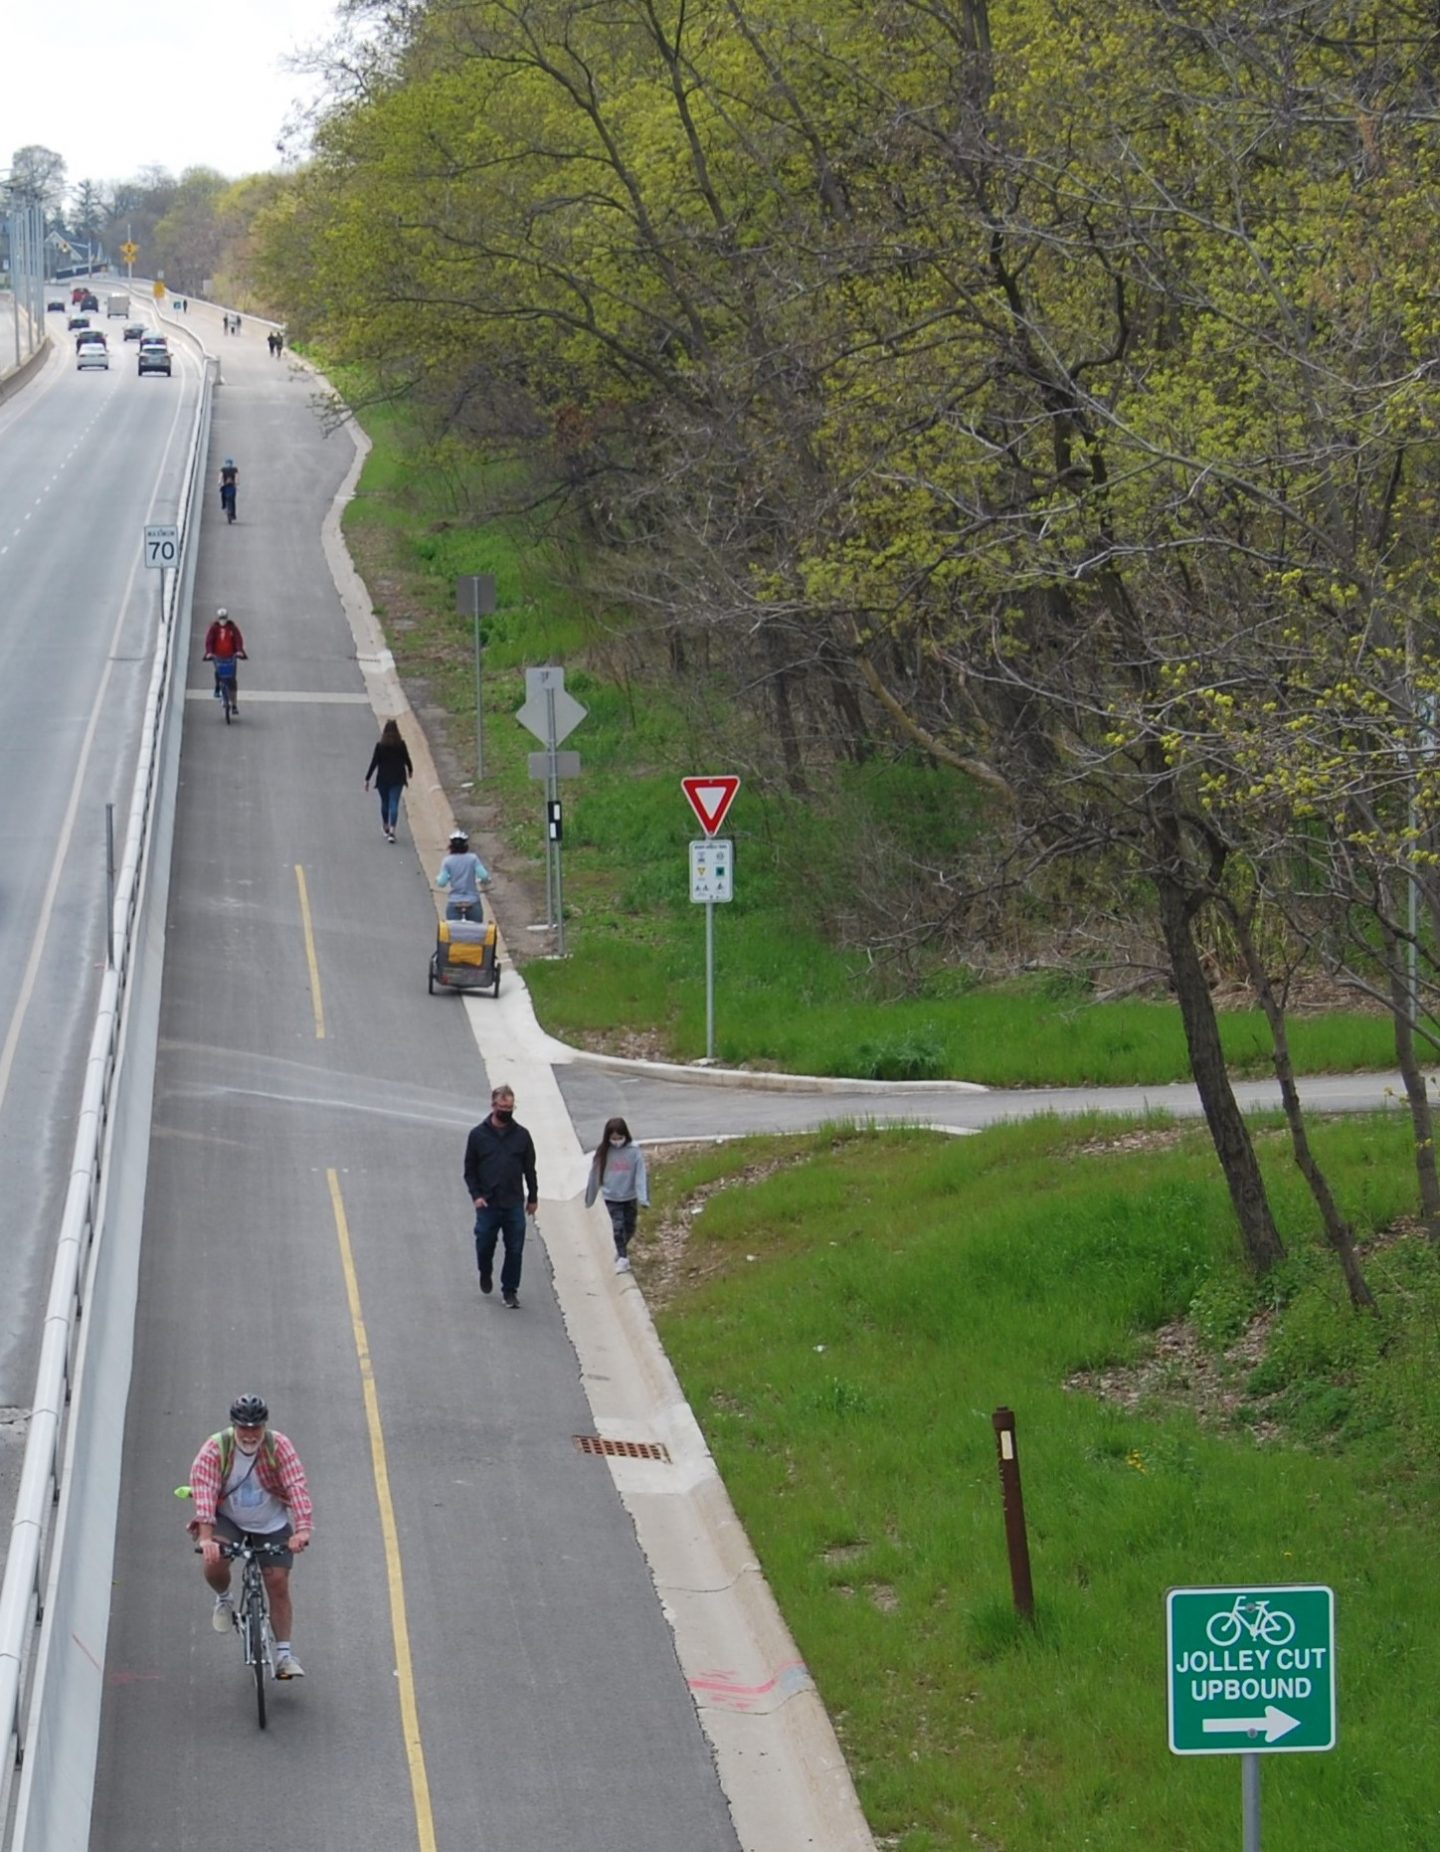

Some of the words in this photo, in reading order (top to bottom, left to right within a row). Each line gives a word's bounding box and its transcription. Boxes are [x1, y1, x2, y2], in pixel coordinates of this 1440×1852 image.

[148, 541, 175, 560] 70
[1176, 1650, 1270, 1673] JOLLEY
[1276, 1648, 1327, 1670] CUT
[1191, 1677, 1312, 1701] UPBOUND
